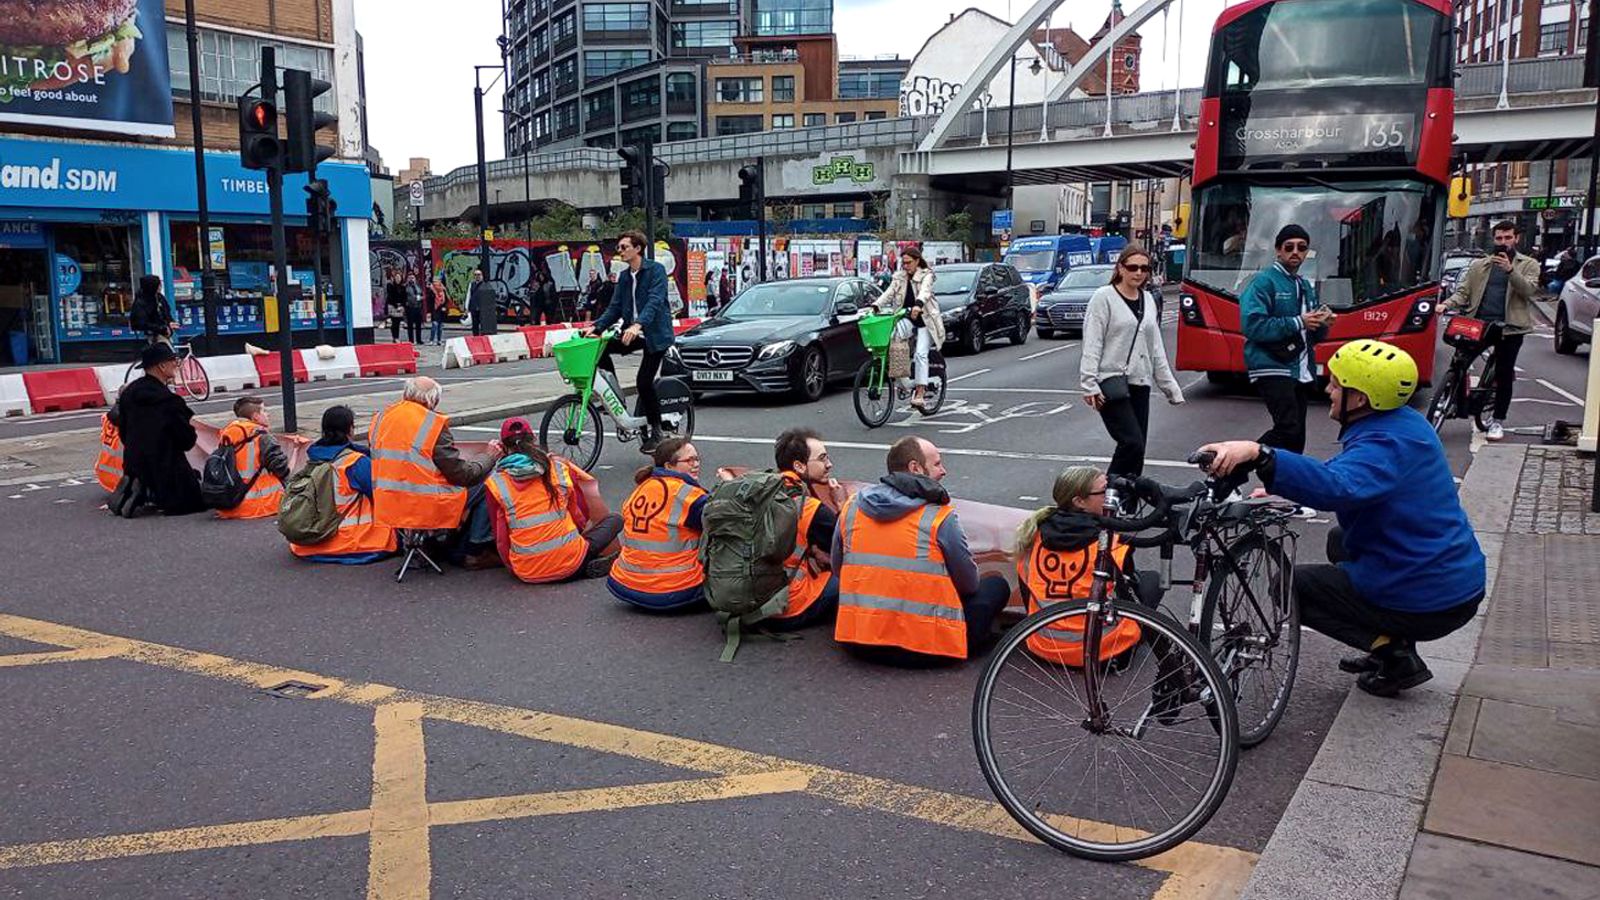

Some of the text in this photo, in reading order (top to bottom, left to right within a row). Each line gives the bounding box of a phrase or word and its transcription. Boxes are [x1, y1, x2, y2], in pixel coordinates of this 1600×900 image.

[9, 86, 31, 98] feel
[34, 90, 62, 101] good
[65, 91, 98, 103] about
[1235, 121, 1404, 147] Crossharbour 135
[1530, 198, 1558, 208] PIZA
[1363, 311, 1389, 321] 13129
